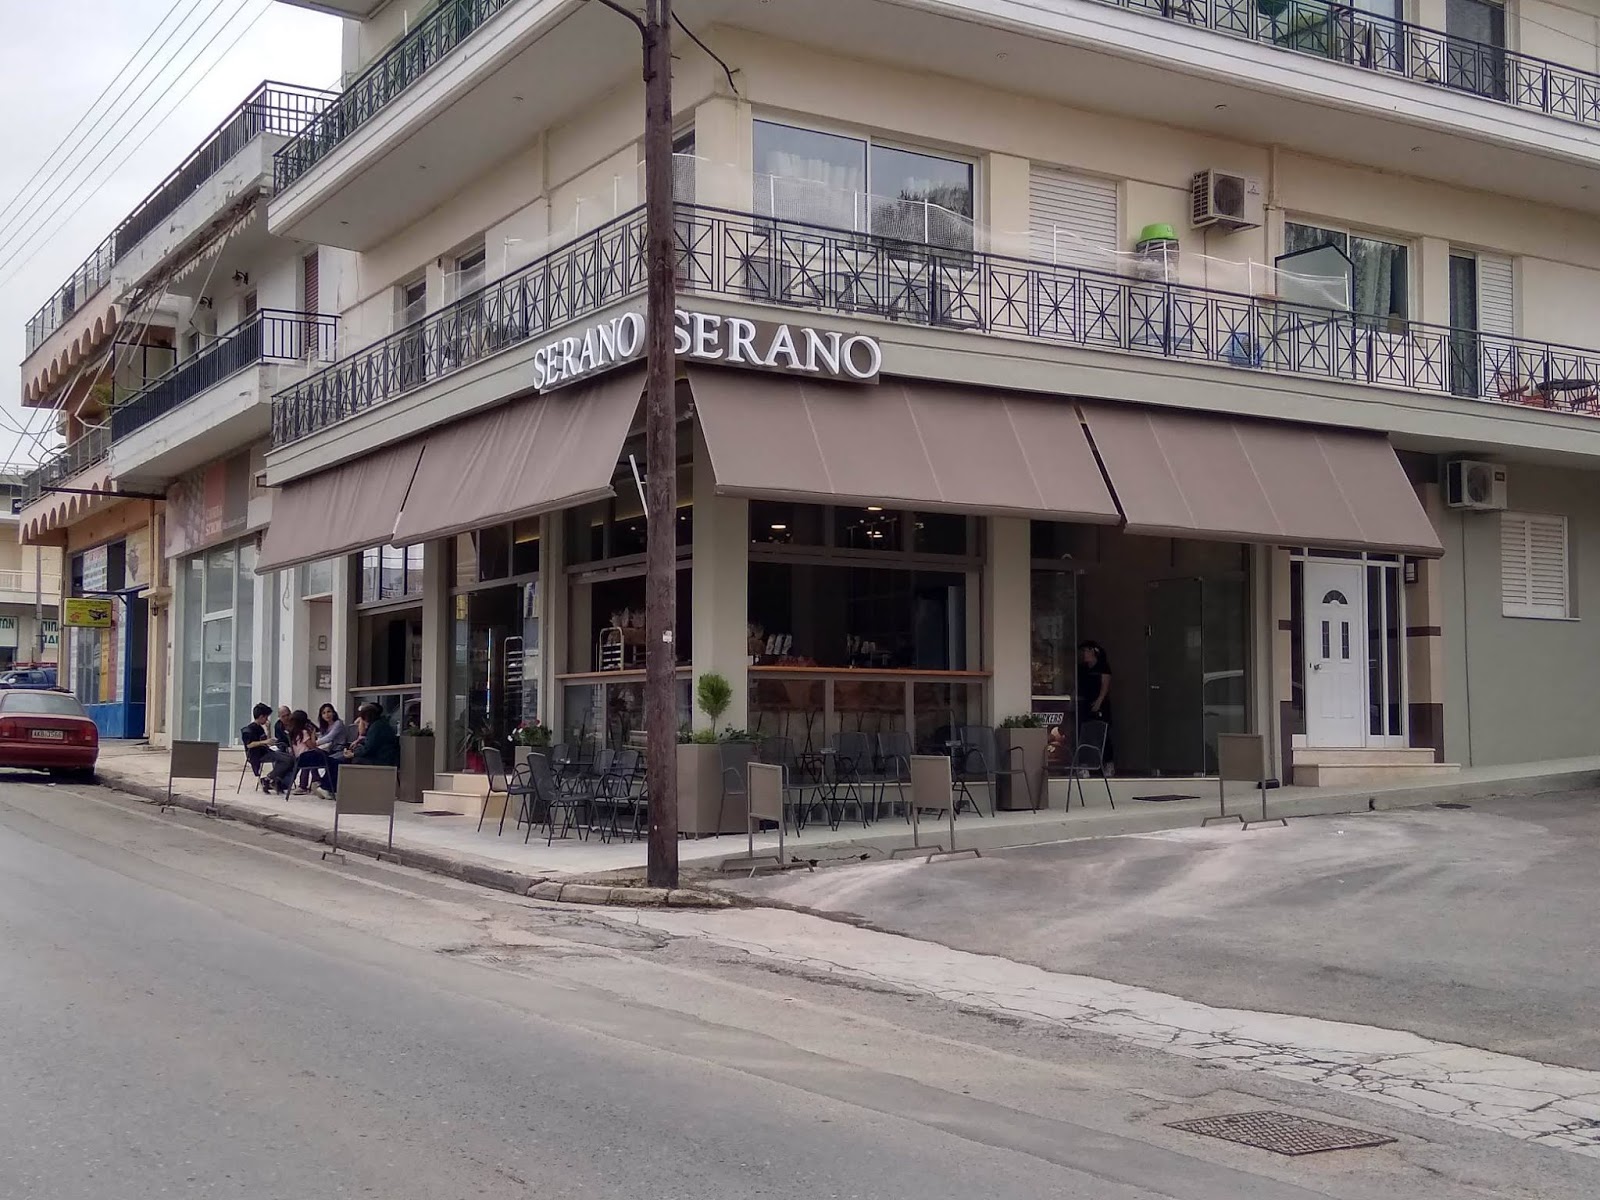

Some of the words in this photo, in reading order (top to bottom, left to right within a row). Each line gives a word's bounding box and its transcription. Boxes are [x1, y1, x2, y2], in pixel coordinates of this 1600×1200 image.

[533, 312, 646, 389] SERANO
[674, 309, 882, 378] SERANO
[1033, 713, 1063, 724] CKERS
